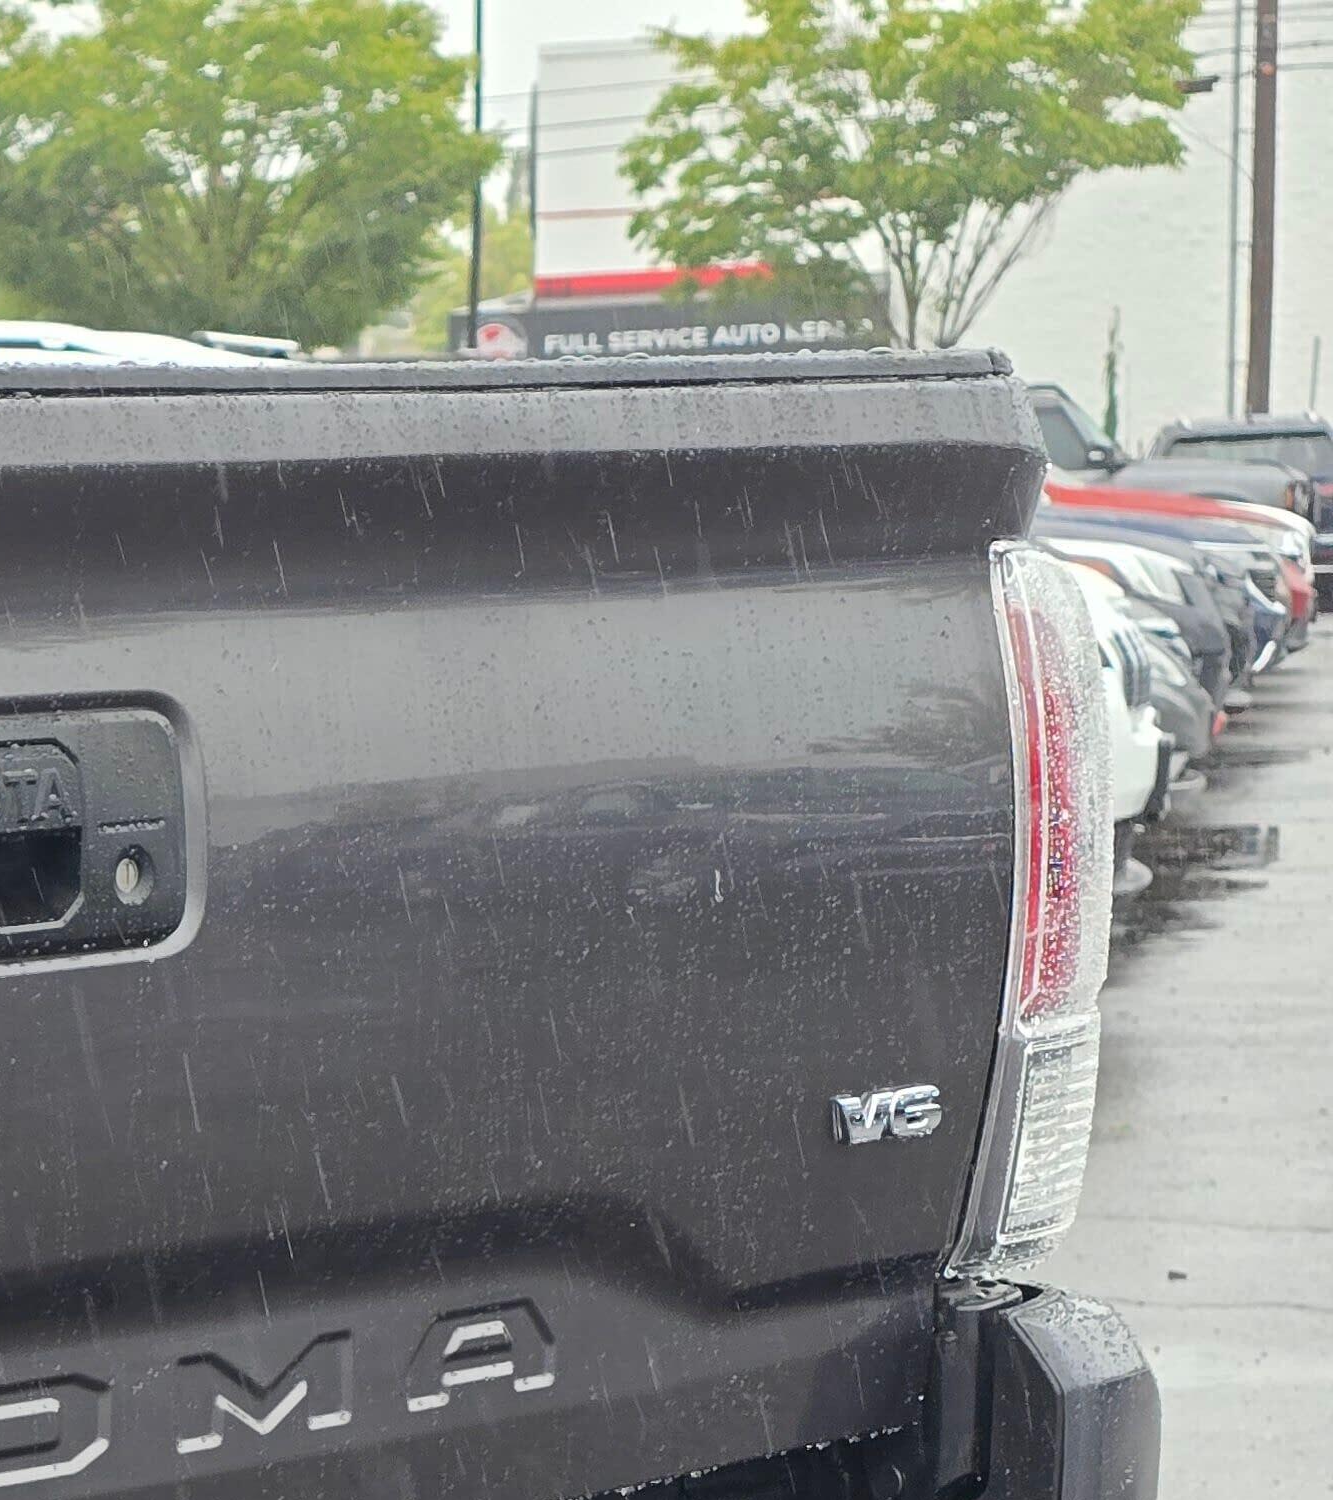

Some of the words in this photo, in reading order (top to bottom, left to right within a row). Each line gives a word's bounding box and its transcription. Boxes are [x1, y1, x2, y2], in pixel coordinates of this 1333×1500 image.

[544, 333, 603, 355] FULL
[608, 326, 710, 352] SERVICE
[712, 322, 781, 347] AUTO
[829, 1083, 943, 1145] V6
